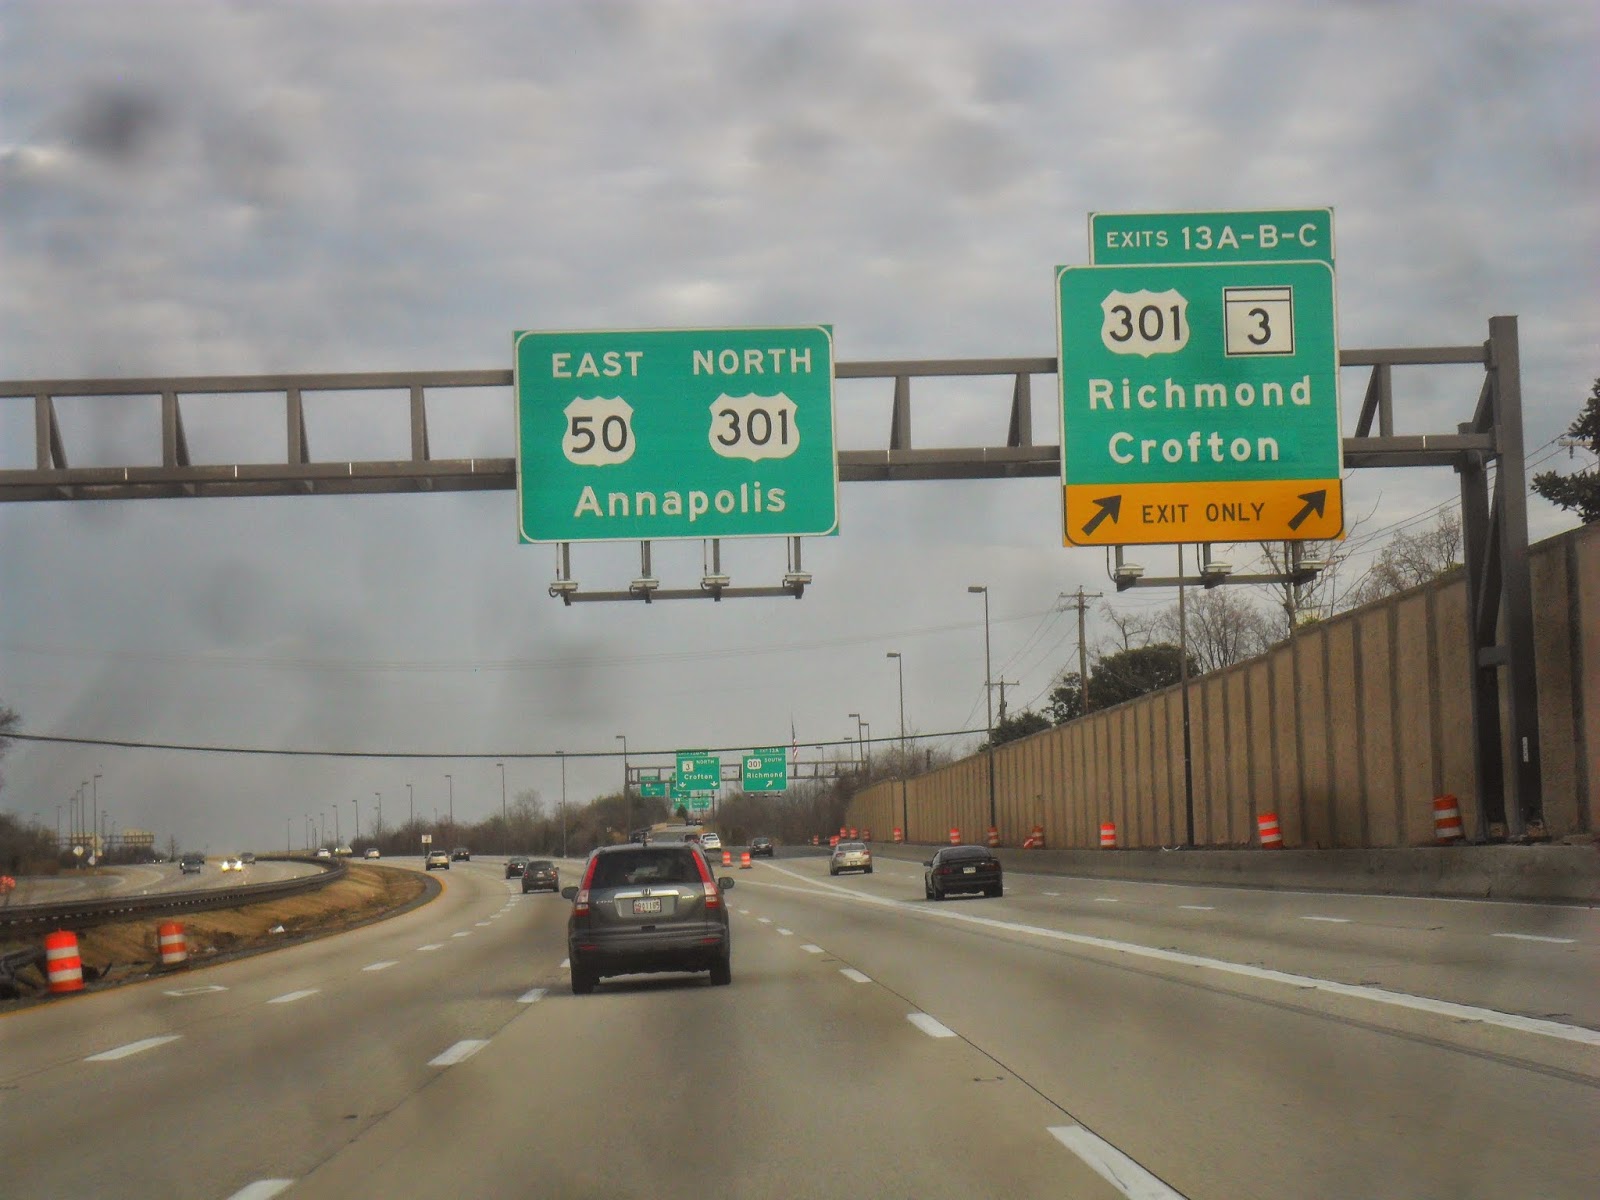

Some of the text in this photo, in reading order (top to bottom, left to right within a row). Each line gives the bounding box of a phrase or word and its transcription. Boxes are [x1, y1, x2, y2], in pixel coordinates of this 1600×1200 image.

[1106, 223, 1317, 250] EXITS 13A-B-C
[1109, 304, 1181, 342] 301
[1247, 307, 1272, 345] 3
[552, 351, 644, 378] EAST
[693, 348, 812, 375] NORTH
[1088, 375, 1311, 410] Richmond
[571, 415, 628, 453] 50
[717, 408, 788, 446] 301
[1108, 431, 1279, 464] Crofton
[573, 481, 786, 522] Annapolis
[1142, 502, 1265, 524] EXIT ONLY
[748, 760, 761, 768] 301
